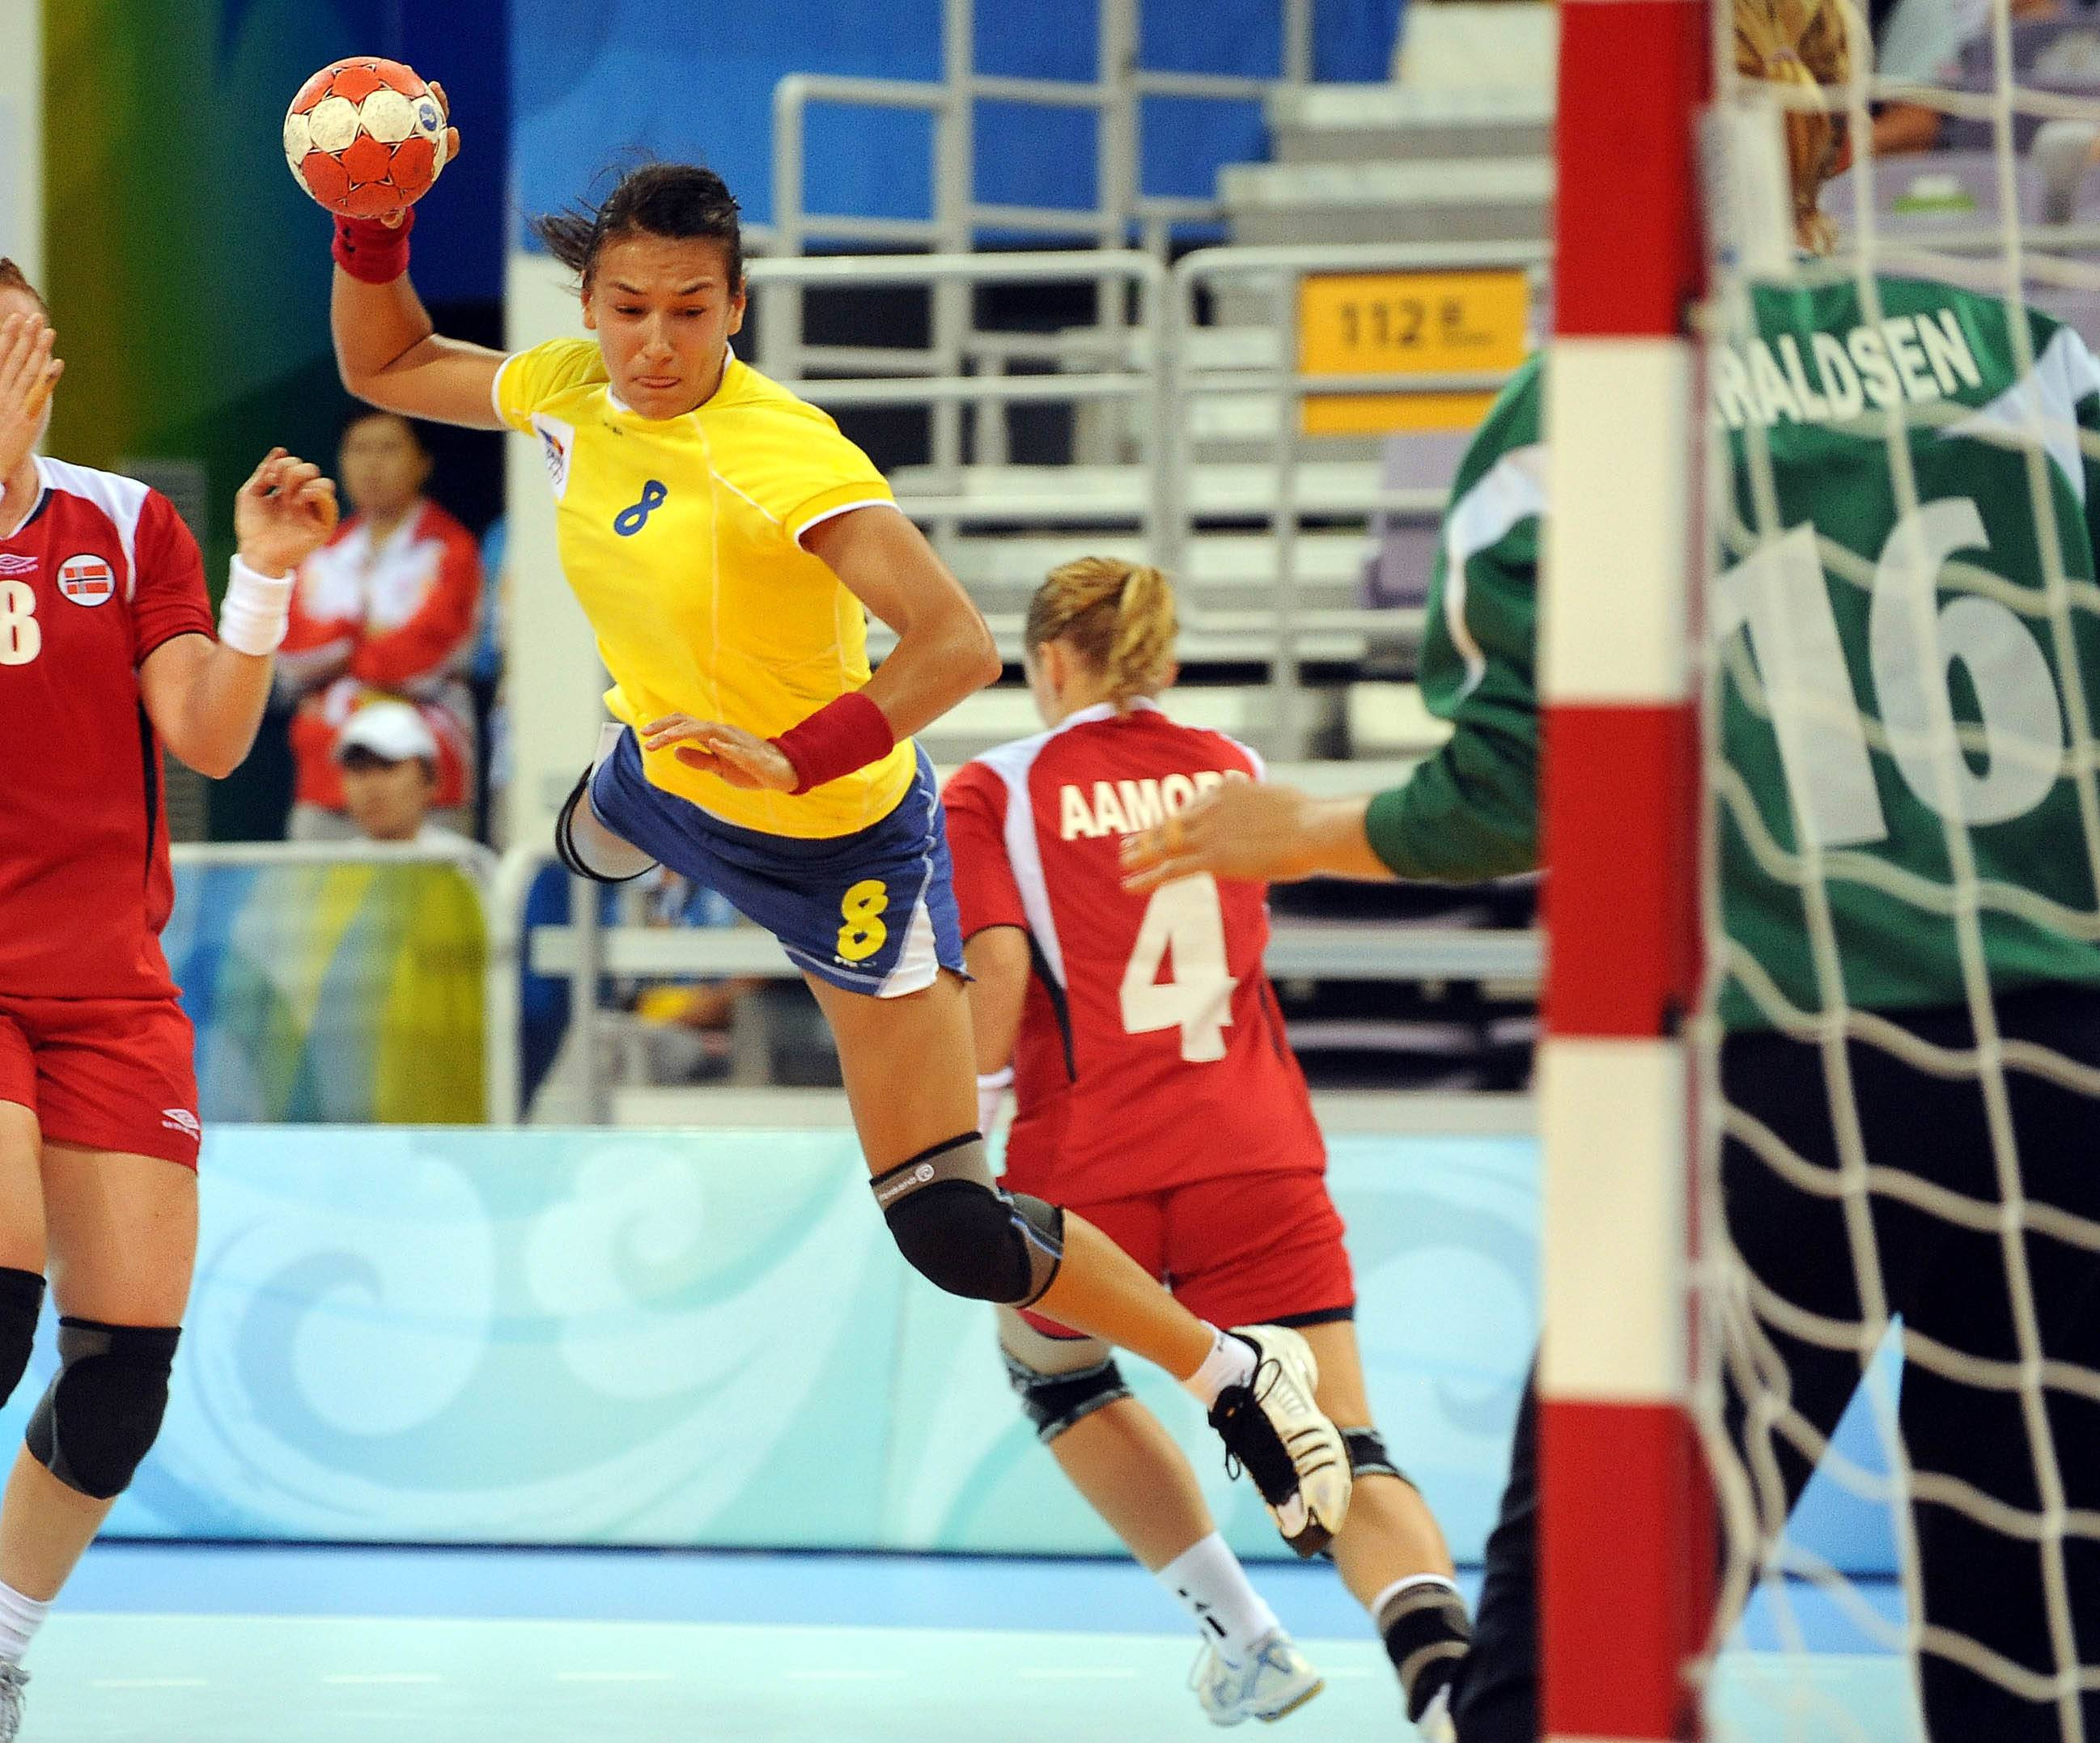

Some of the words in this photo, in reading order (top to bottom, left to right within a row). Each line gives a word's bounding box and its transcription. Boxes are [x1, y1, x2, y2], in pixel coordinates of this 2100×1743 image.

[1340, 299, 1423, 348] 112
[1708, 310, 1981, 426] RALDSEN
[614, 479, 668, 536] 8
[1709, 497, 2064, 846] 16
[837, 880, 889, 961] 8
[1120, 871, 1241, 1062] 4
